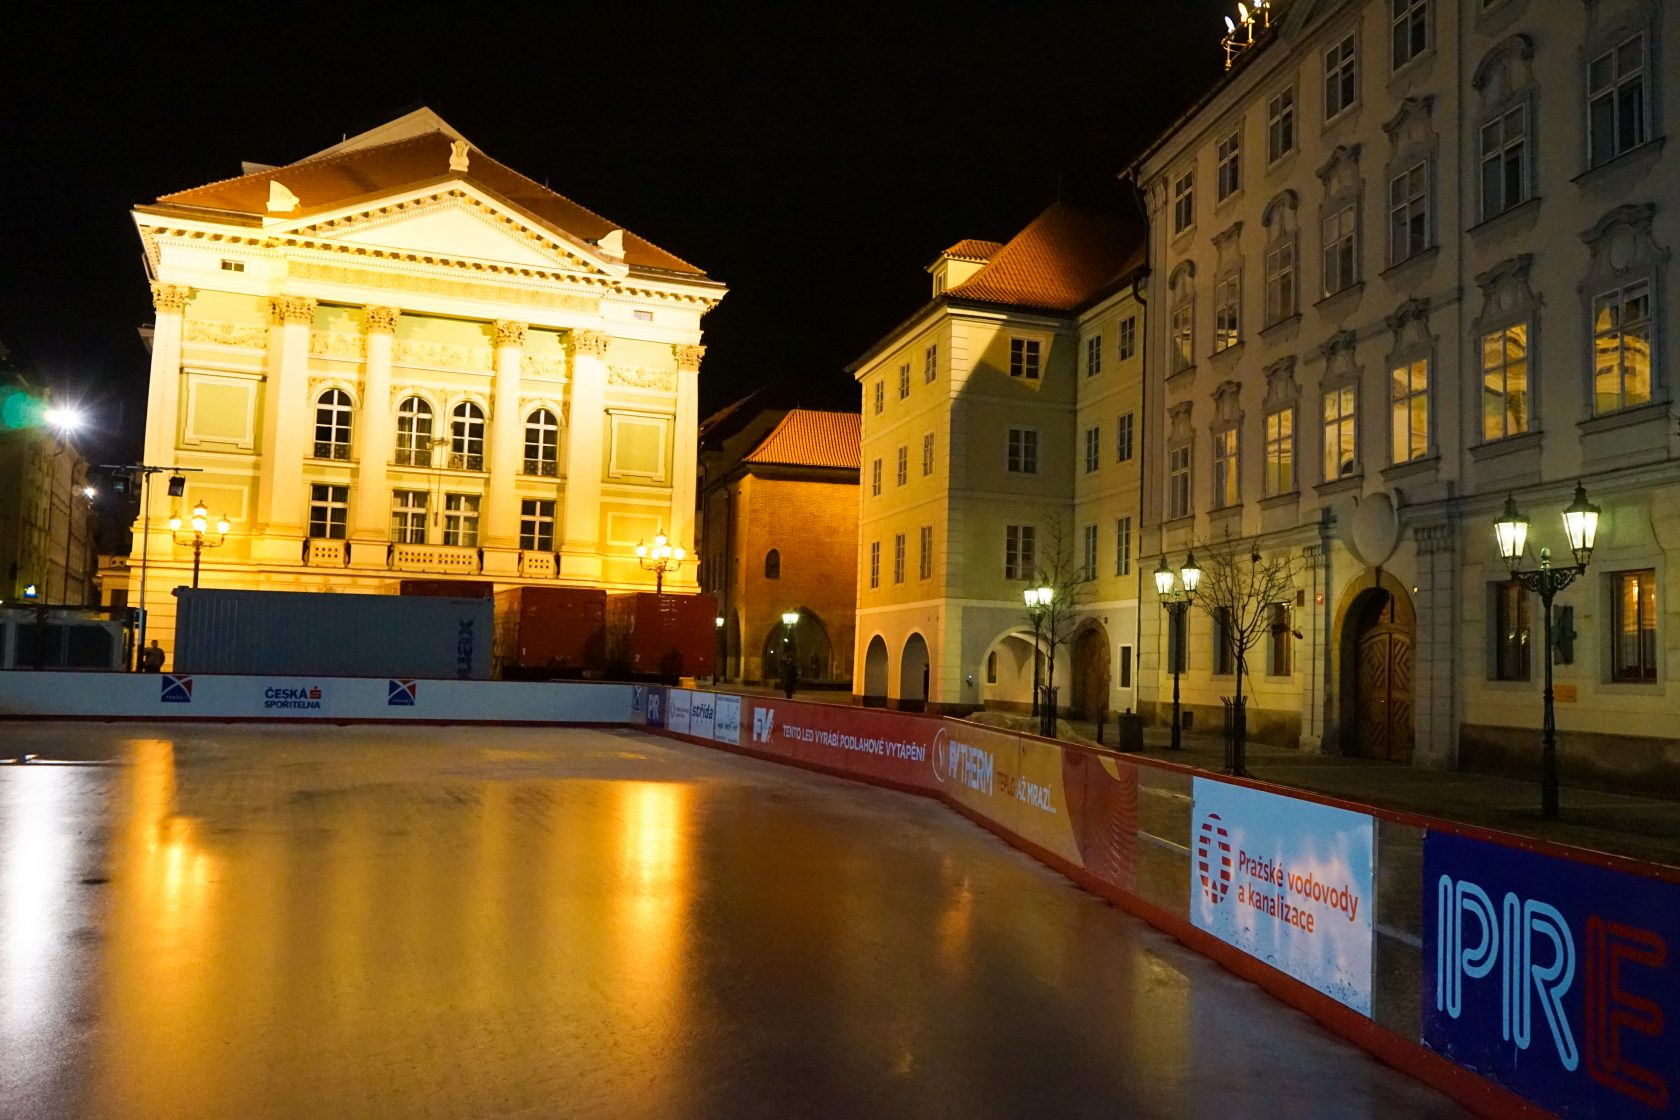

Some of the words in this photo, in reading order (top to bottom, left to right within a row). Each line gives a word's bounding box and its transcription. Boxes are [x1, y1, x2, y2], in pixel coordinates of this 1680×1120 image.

[264, 699, 320, 709] SPOŘITELNA
[265, 686, 307, 699] ČESKÁ
[783, 724, 801, 740] TENTO
[802, 728, 814, 742] LED
[815, 729, 839, 747] VYRÁBÍ
[839, 734, 884, 755] PODLAHOVÉ
[885, 740, 926, 762] VYTÁPĚNÍ
[1238, 849, 1284, 888] Pražské
[1287, 870, 1359, 922] vodovody
[1238, 883, 1245, 904] a
[1248, 882, 1314, 933] kanalizace
[1437, 874, 1669, 1108] PRE
